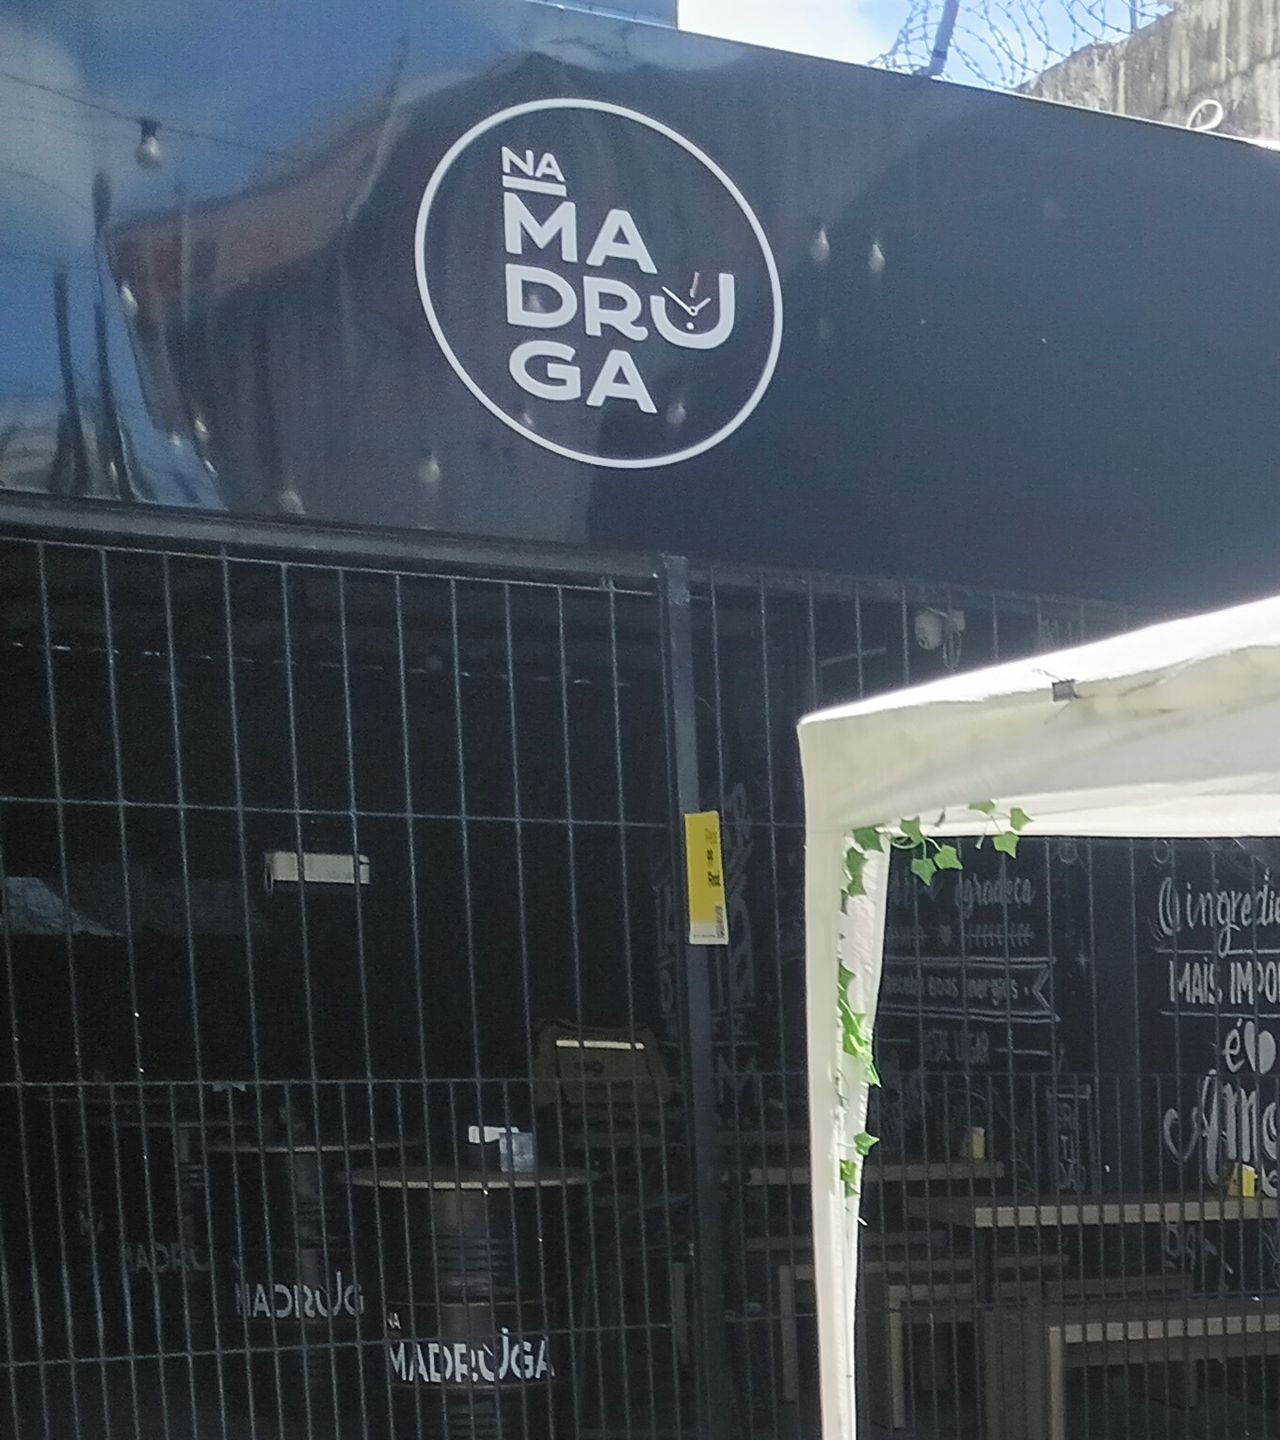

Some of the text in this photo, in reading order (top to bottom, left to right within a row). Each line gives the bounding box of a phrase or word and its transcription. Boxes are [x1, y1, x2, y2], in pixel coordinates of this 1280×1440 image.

[501, 145, 565, 182] NA
[503, 191, 658, 274] MA
[508, 340, 658, 414] GA
